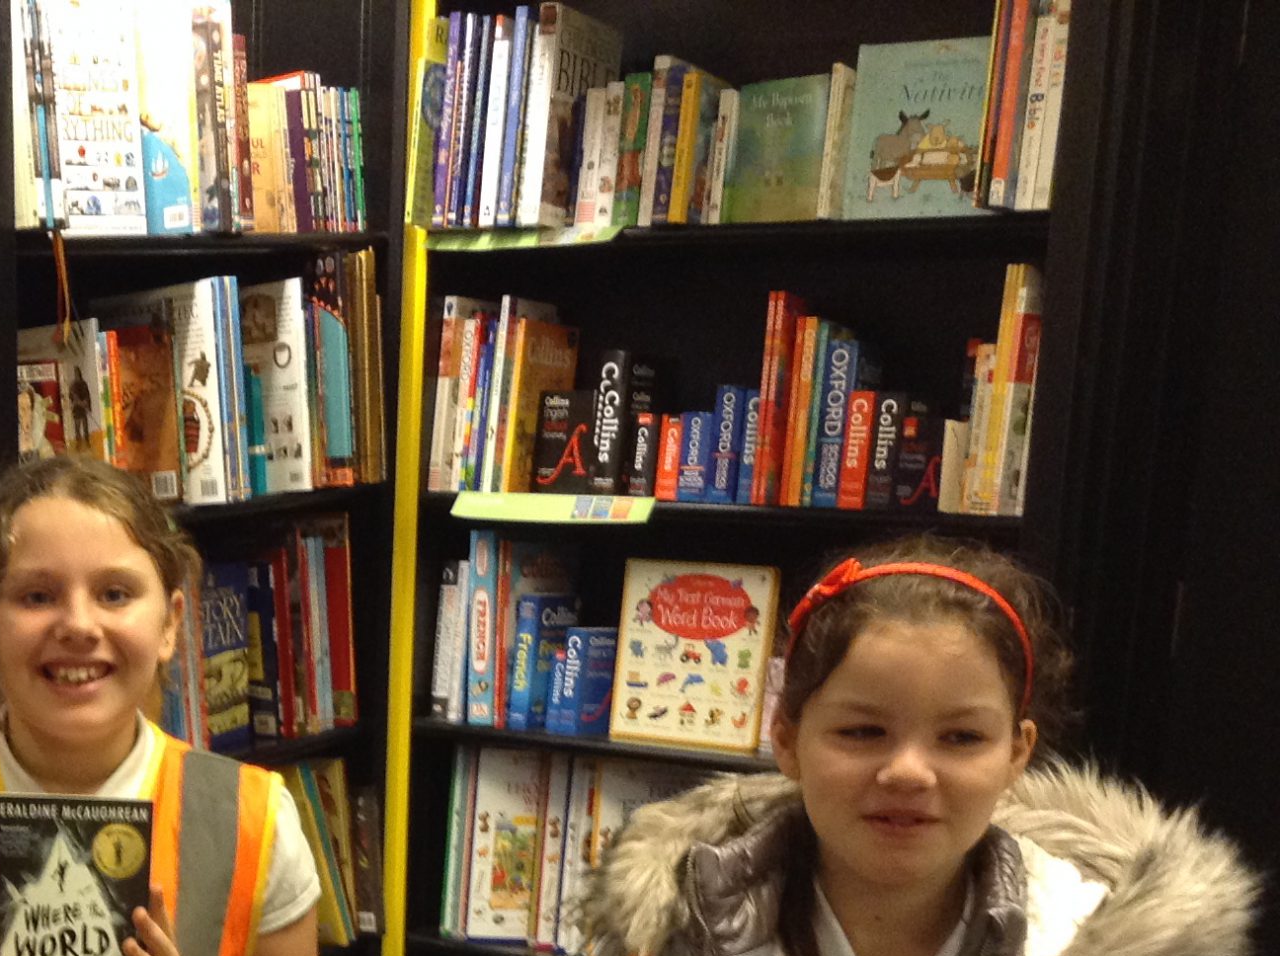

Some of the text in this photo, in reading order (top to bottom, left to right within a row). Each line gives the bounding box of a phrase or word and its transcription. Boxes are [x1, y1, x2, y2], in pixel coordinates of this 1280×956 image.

[211, 49, 226, 124] TIME ATLAS
[62, 116, 134, 144] RYTHING
[1026, 92, 1045, 131] Bible
[544, 395, 569, 407] Collins
[718, 392, 736, 453] OXFORD
[824, 348, 849, 487] OXFORD SCHOOL
[598, 389, 620, 464] Collins
[634, 427, 650, 471] Collins
[664, 427, 679, 472] Collins
[687, 416, 701, 466] OXFORD
[742, 396, 761, 465] Collins
[846, 398, 868, 468] Collins
[875, 398, 898, 470] Collins
[542, 606, 579, 626] Collins
[657, 604, 738, 630] Word Book
[678, 588, 701, 603] First
[514, 632, 533, 692] French
[552, 662, 565, 705] Collins
[564, 635, 581, 698] Collins
[23, 902, 82, 932] WHERE
